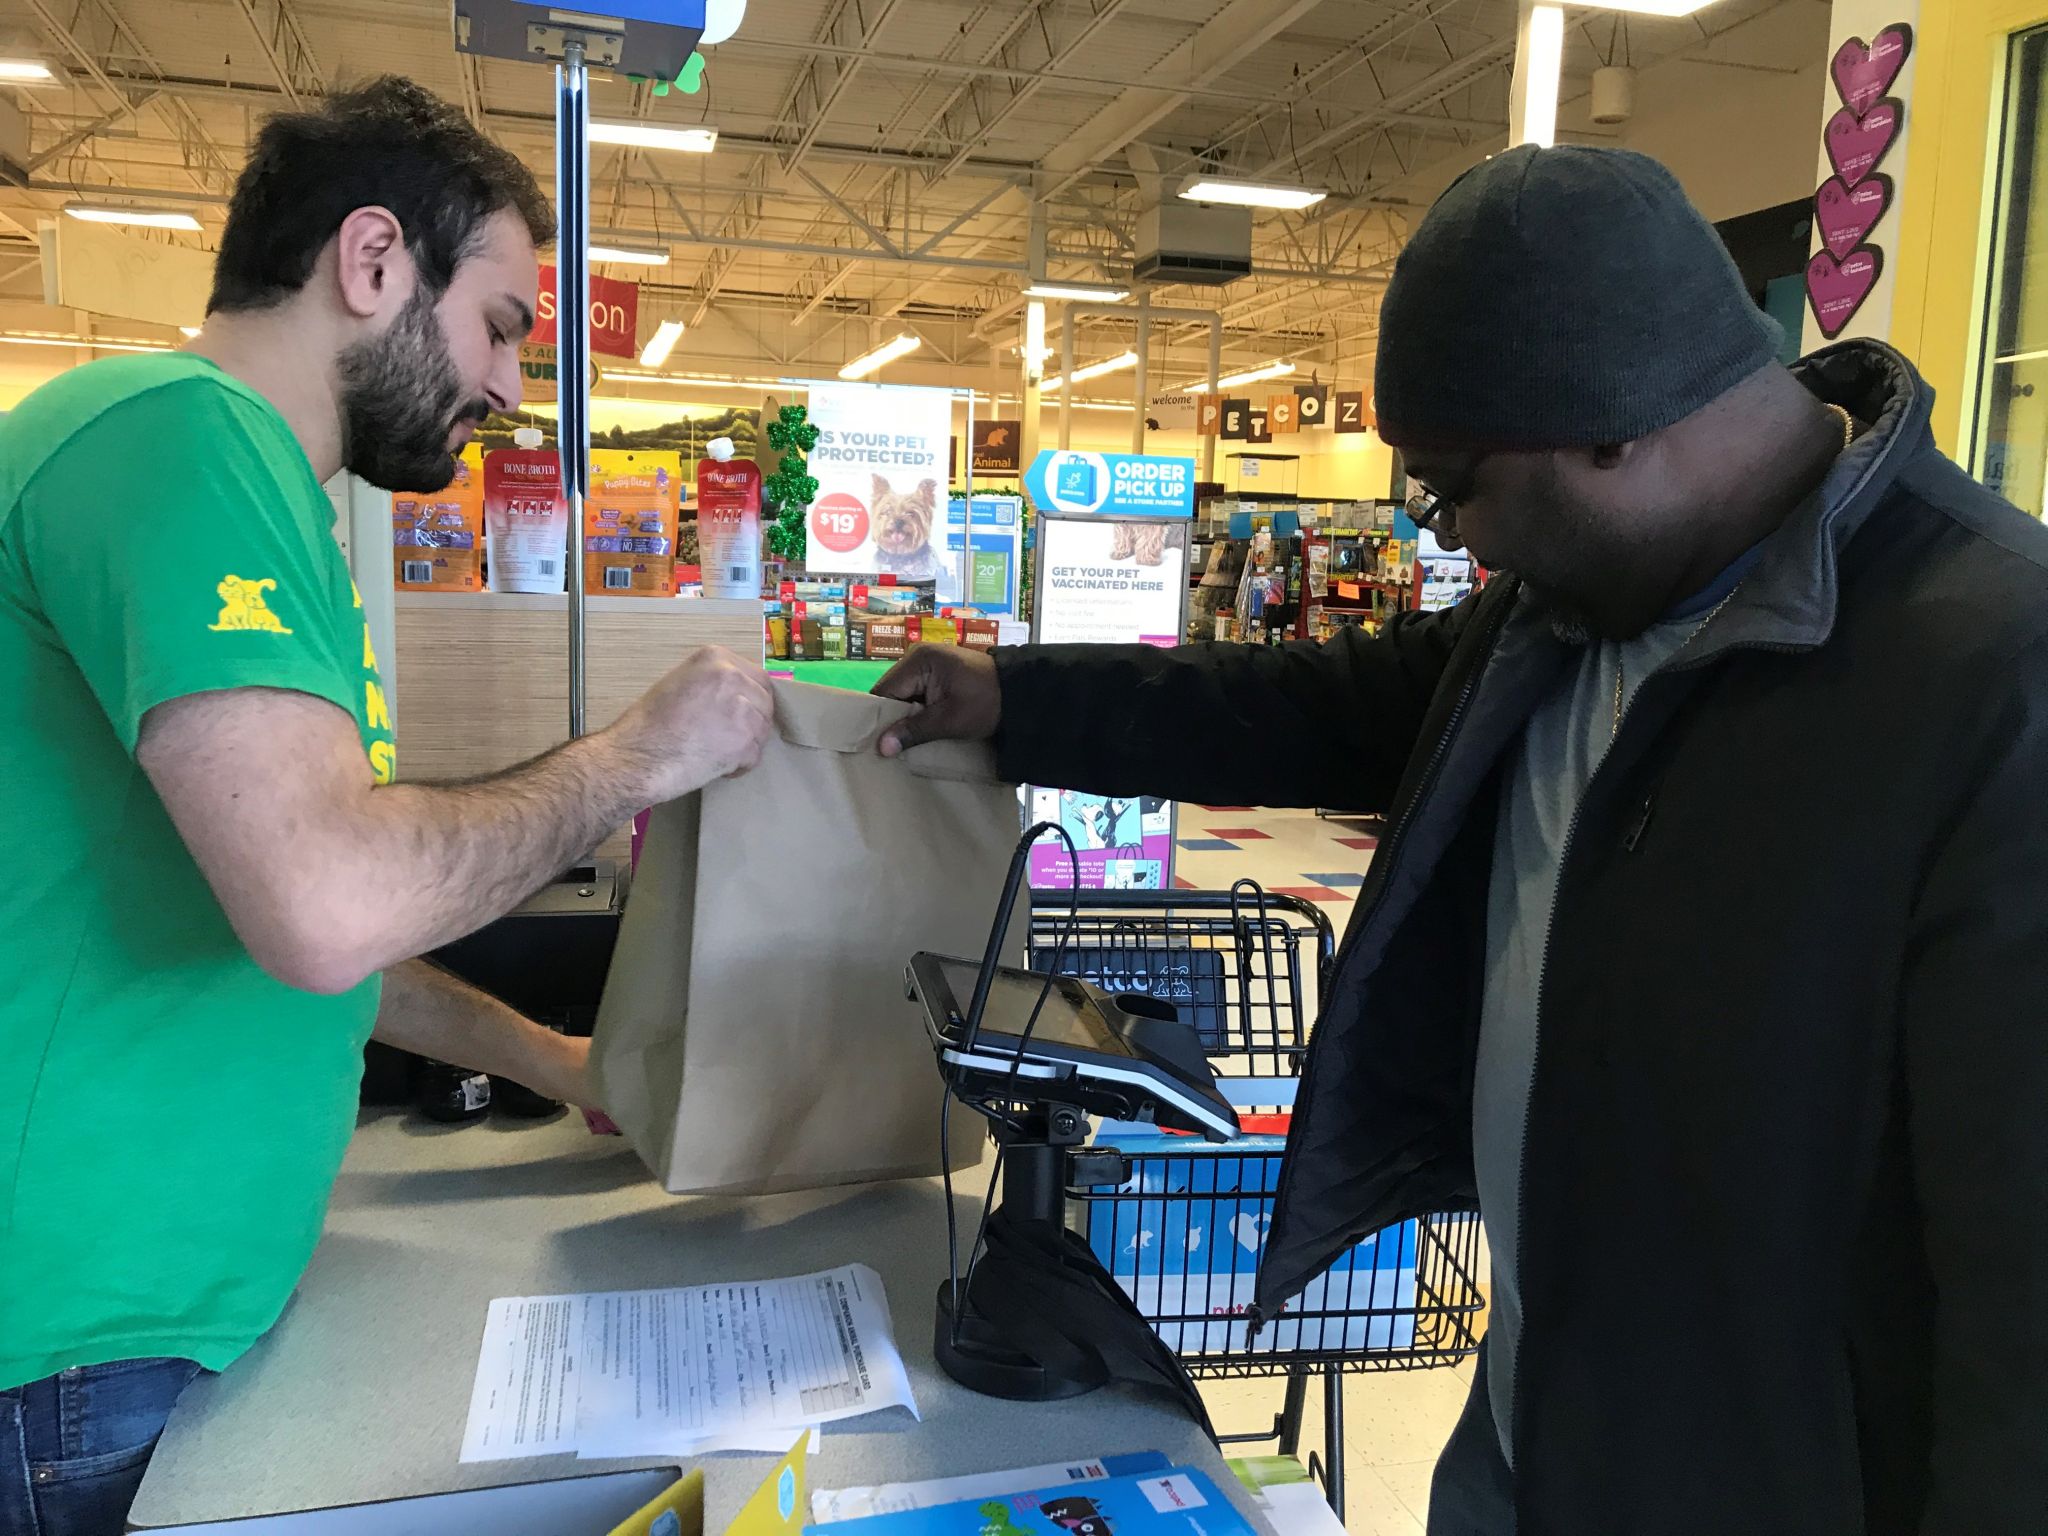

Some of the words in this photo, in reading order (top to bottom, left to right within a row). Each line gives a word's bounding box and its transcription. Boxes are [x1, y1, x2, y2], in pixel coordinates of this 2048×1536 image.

[538, 291, 626, 335] son
[1152, 393, 1192, 405] welcome
[840, 431, 891, 448] YOUR
[895, 434, 928, 450] PET
[817, 446, 936, 467] PROTECTED?
[973, 456, 1011, 468] Animal
[503, 463, 527, 475] BONE
[528, 464, 556, 476] BROTH
[1114, 461, 1186, 481] ORDER
[604, 479, 629, 490] Puppy
[707, 472, 726, 484] BONE
[1114, 479, 1157, 497] PICK
[1160, 482, 1185, 498] UP
[1051, 566, 1077, 577] GET
[1080, 567, 1114, 578] YOUR
[1116, 568, 1140, 578] PET
[1051, 578, 1129, 591] VACCINATED
[1131, 580, 1164, 592] HERE
[965, 632, 995, 643] REGIONAL
[853, 1344, 867, 1375] PURCHASE
[860, 1374, 872, 1391] CARD
